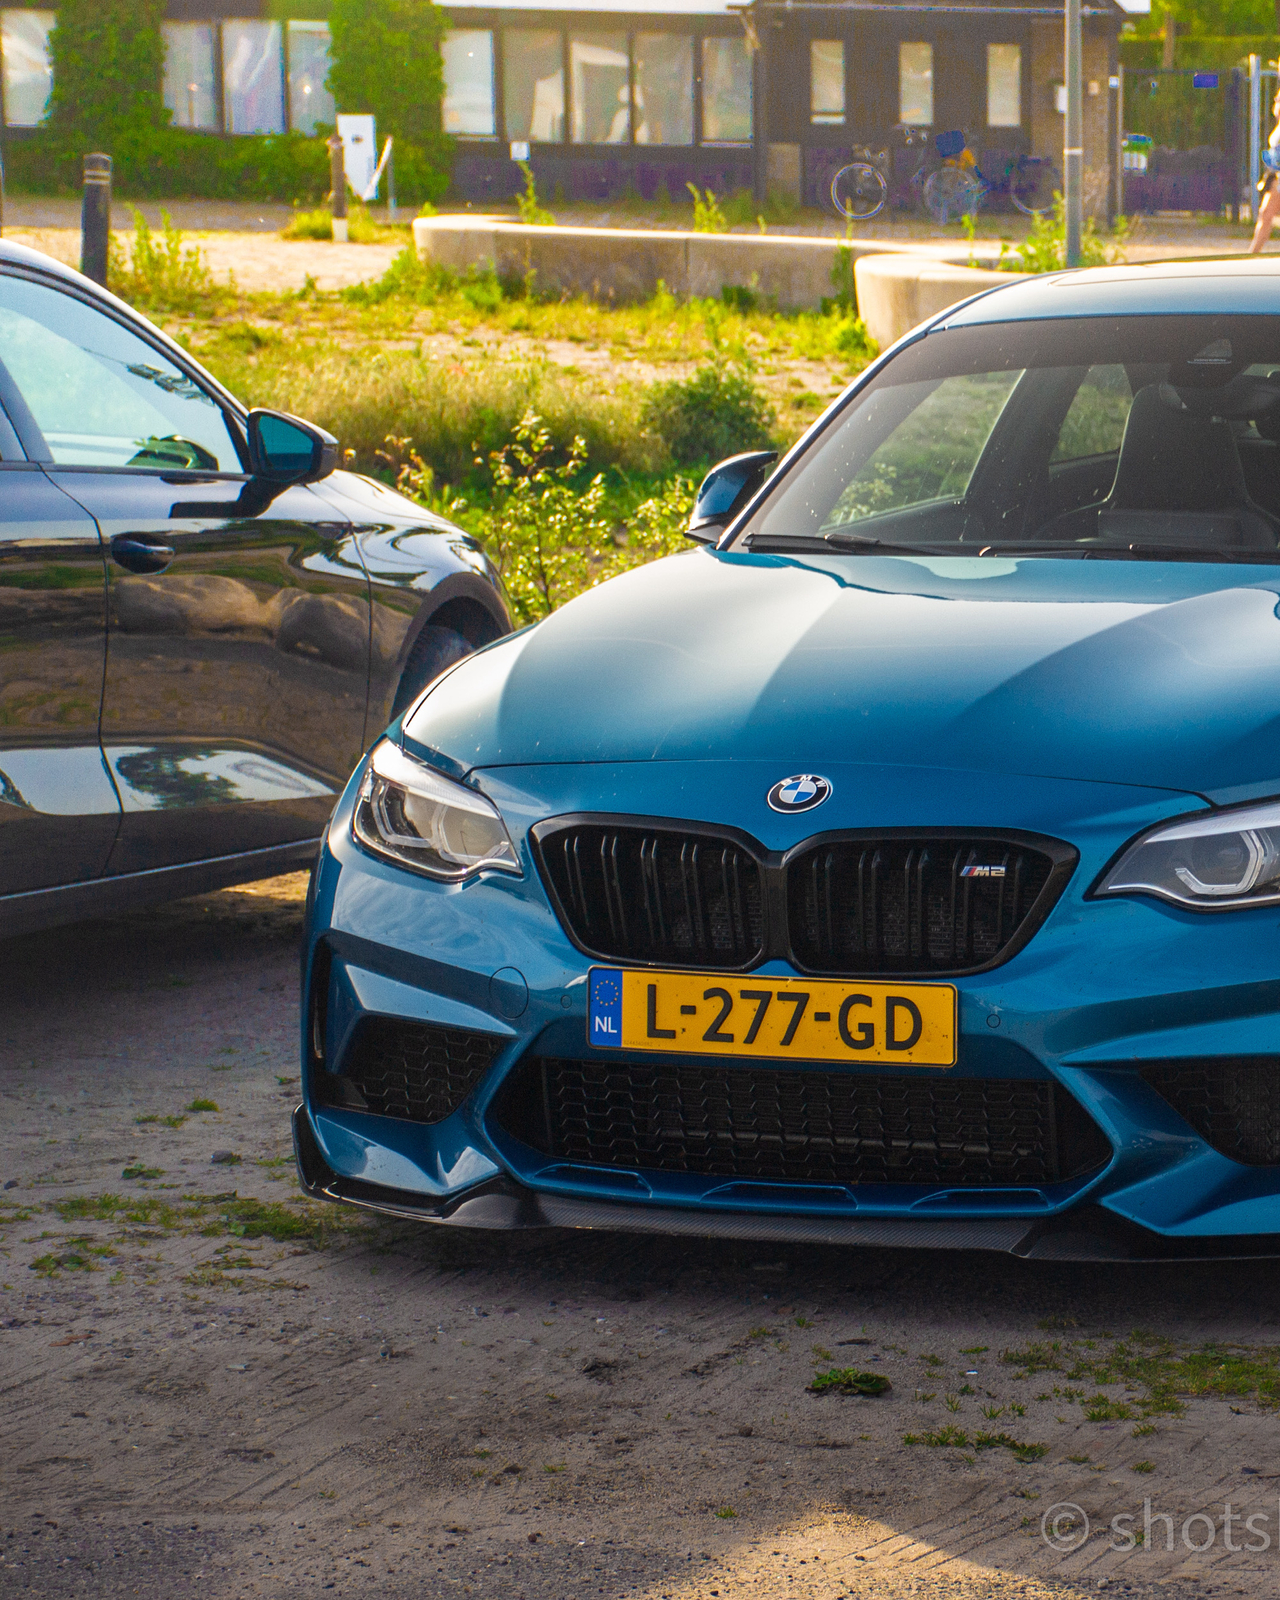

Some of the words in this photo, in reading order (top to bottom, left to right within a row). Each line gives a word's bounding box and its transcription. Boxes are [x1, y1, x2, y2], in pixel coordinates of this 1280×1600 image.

[780, 774, 827, 788] BMW
[970, 865, 1006, 877] M2
[595, 1016, 617, 1034] NL
[647, 984, 922, 1051] L-277-GD
